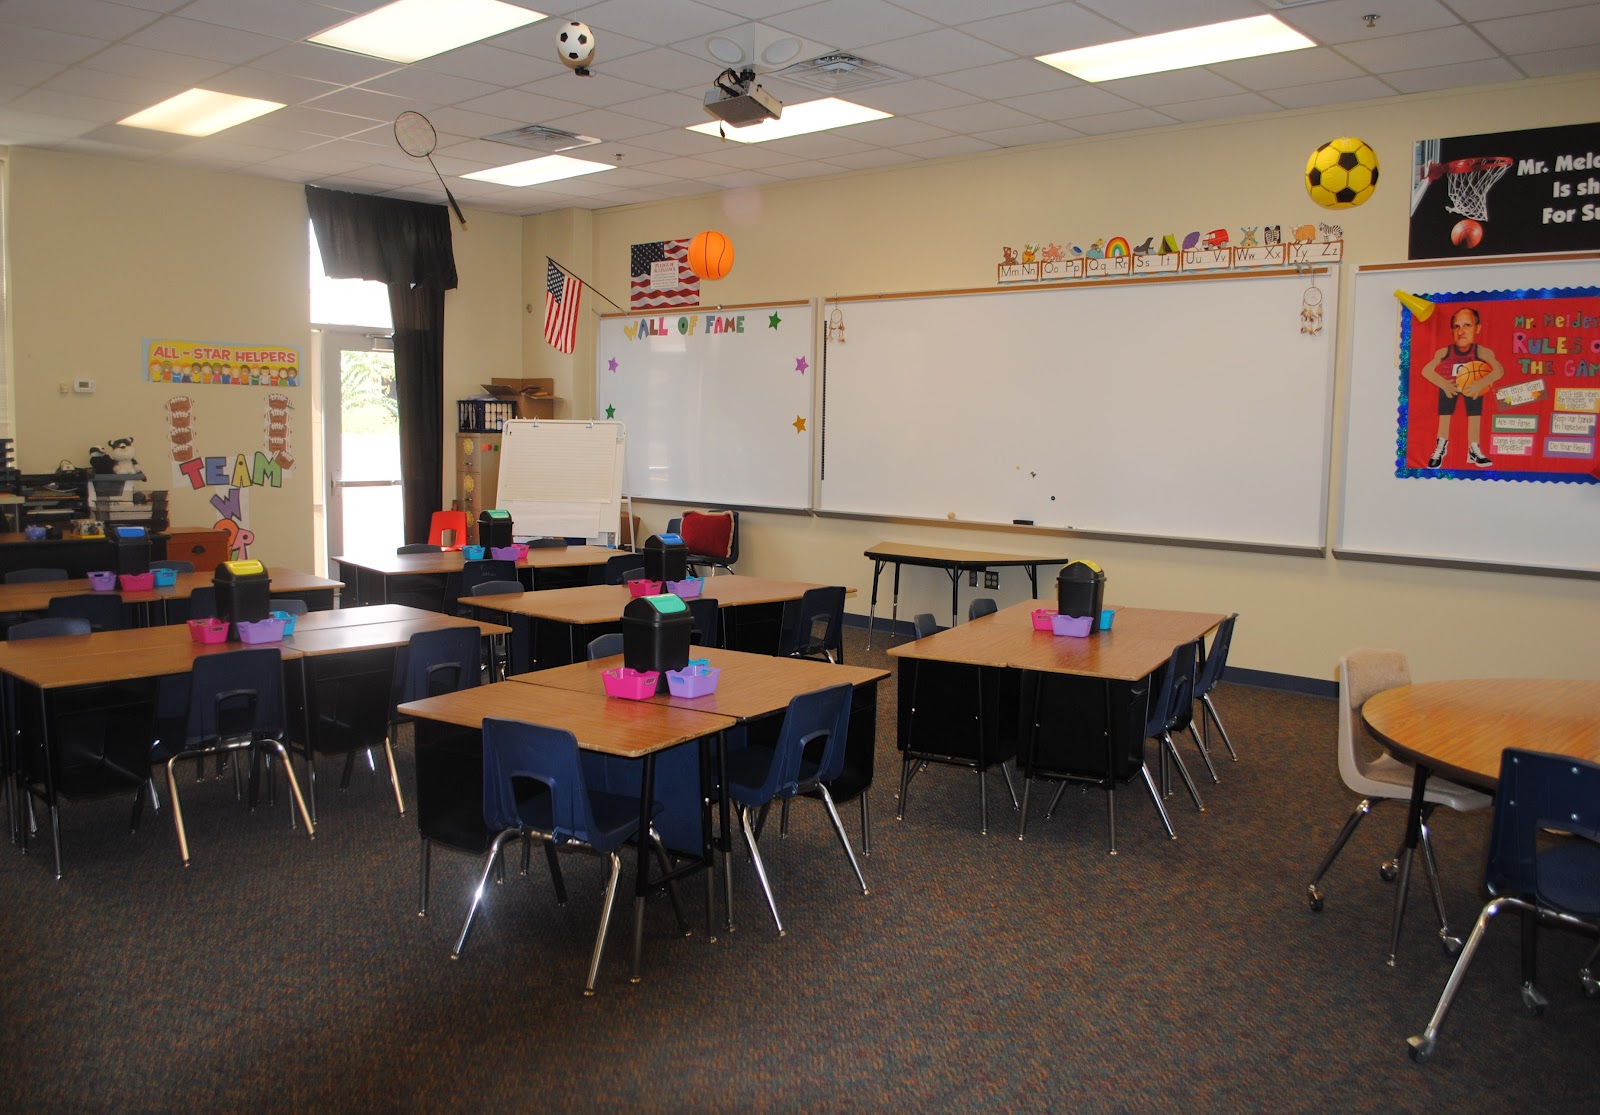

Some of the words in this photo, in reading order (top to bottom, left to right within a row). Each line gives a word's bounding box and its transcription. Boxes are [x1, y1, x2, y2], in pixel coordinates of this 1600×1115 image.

[1517, 159, 1549, 176] Mr.
[1553, 181, 1571, 198] Is
[1542, 207, 1576, 224] For
[1136, 255, 1150, 267] Ss
[1186, 252, 1202, 264] Uu
[1213, 249, 1226, 262] Vv
[1236, 248, 1255, 261] Ww
[1265, 246, 1281, 259] Xx
[1292, 243, 1308, 263] Yy
[1322, 243, 1338, 256] Zz
[1001, 265, 1019, 278] Mm
[1022, 264, 1036, 275] Nn
[1044, 262, 1059, 273] Oo
[1065, 261, 1080, 277] Pp
[1088, 258, 1109, 275] Qq
[1115, 257, 1128, 269] Rr
[624, 316, 668, 341] WALL
[678, 315, 698, 336] OF
[705, 315, 745, 334] FAME
[1515, 315, 1536, 329] Mr.
[1512, 332, 1582, 355] RULES
[235, 351, 296, 364] HELPERS
[1518, 358, 1554, 375] THE
[179, 451, 283, 490] TEAM
